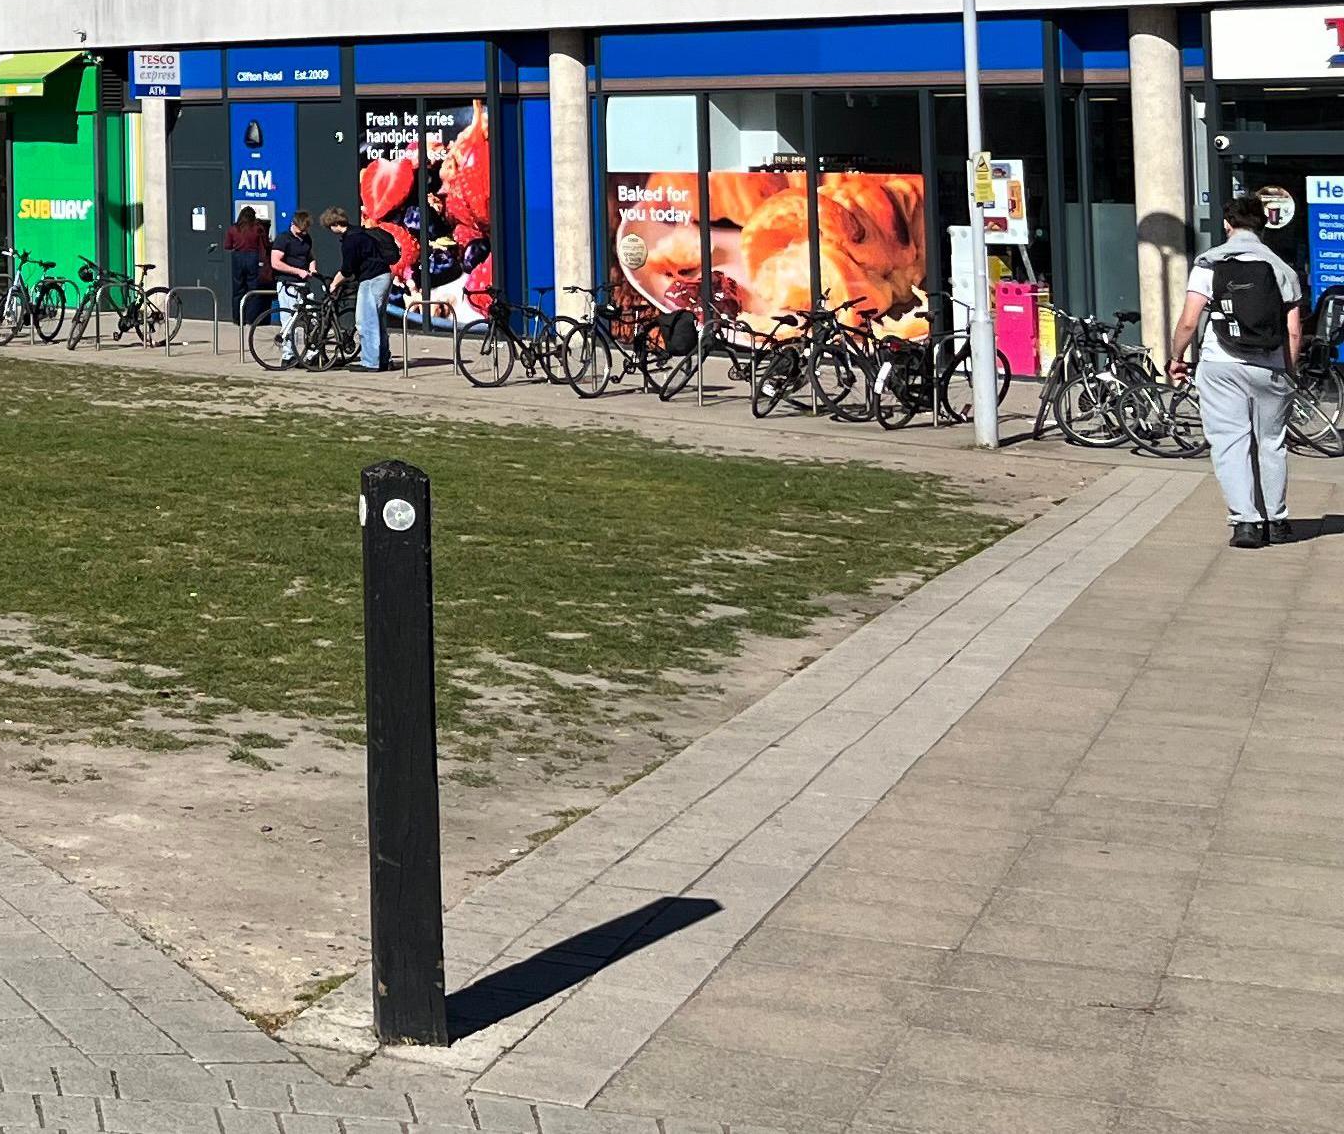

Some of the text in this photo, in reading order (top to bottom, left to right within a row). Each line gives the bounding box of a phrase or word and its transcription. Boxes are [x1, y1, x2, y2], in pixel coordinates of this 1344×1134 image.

[140, 55, 174, 64] TESCO
[140, 70, 175, 81] express
[263, 71, 283, 81] Road
[149, 86, 166, 95] ATM
[366, 112, 398, 126] Fresh
[367, 146, 384, 160] for
[238, 170, 272, 190] ATM
[618, 186, 688, 201] Baked for
[17, 199, 94, 220] SUBWAY
[619, 207, 691, 226] you today
